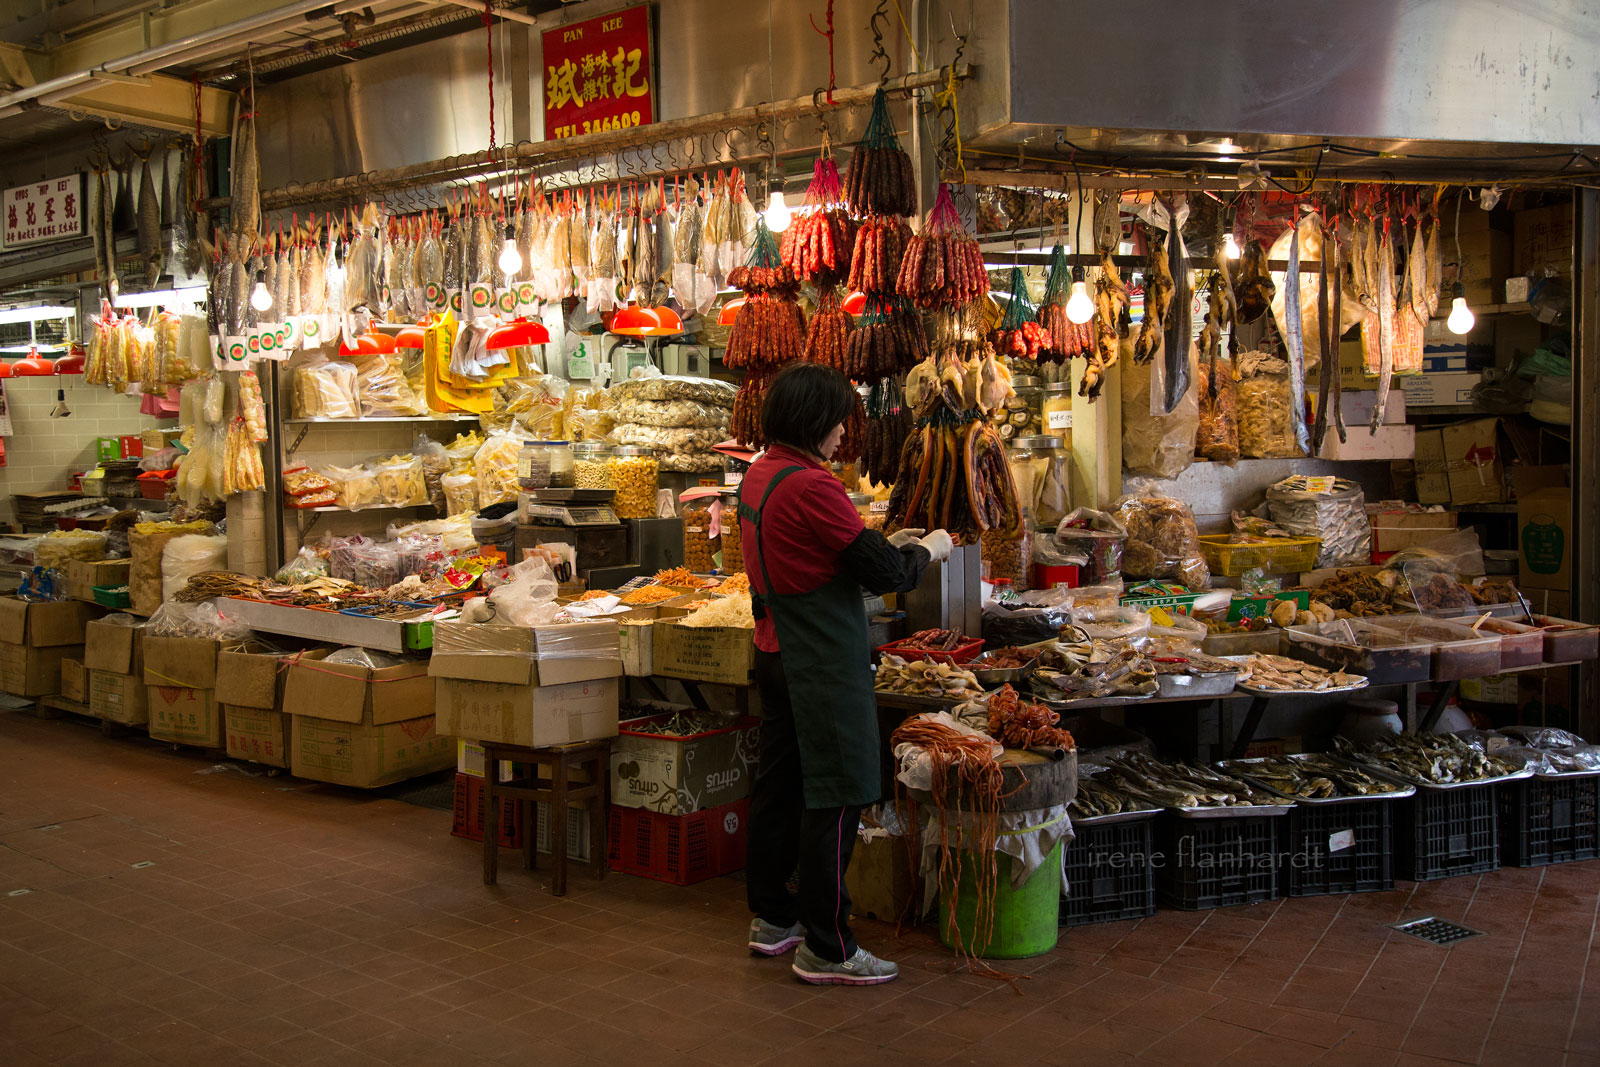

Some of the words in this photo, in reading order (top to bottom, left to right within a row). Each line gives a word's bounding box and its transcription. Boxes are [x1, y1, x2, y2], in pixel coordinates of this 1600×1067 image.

[563, 27, 583, 43] PAN
[602, 16, 623, 33] KEE
[581, 50, 612, 77] 海味
[612, 46, 649, 99] 記
[583, 74, 612, 102] 雜貨
[582, 110, 641, 135] 346609
[572, 342, 586, 358] 3
[629, 779, 659, 797] citrus
[706, 767, 741, 788] citrus
[726, 817, 737, 830] 5A
